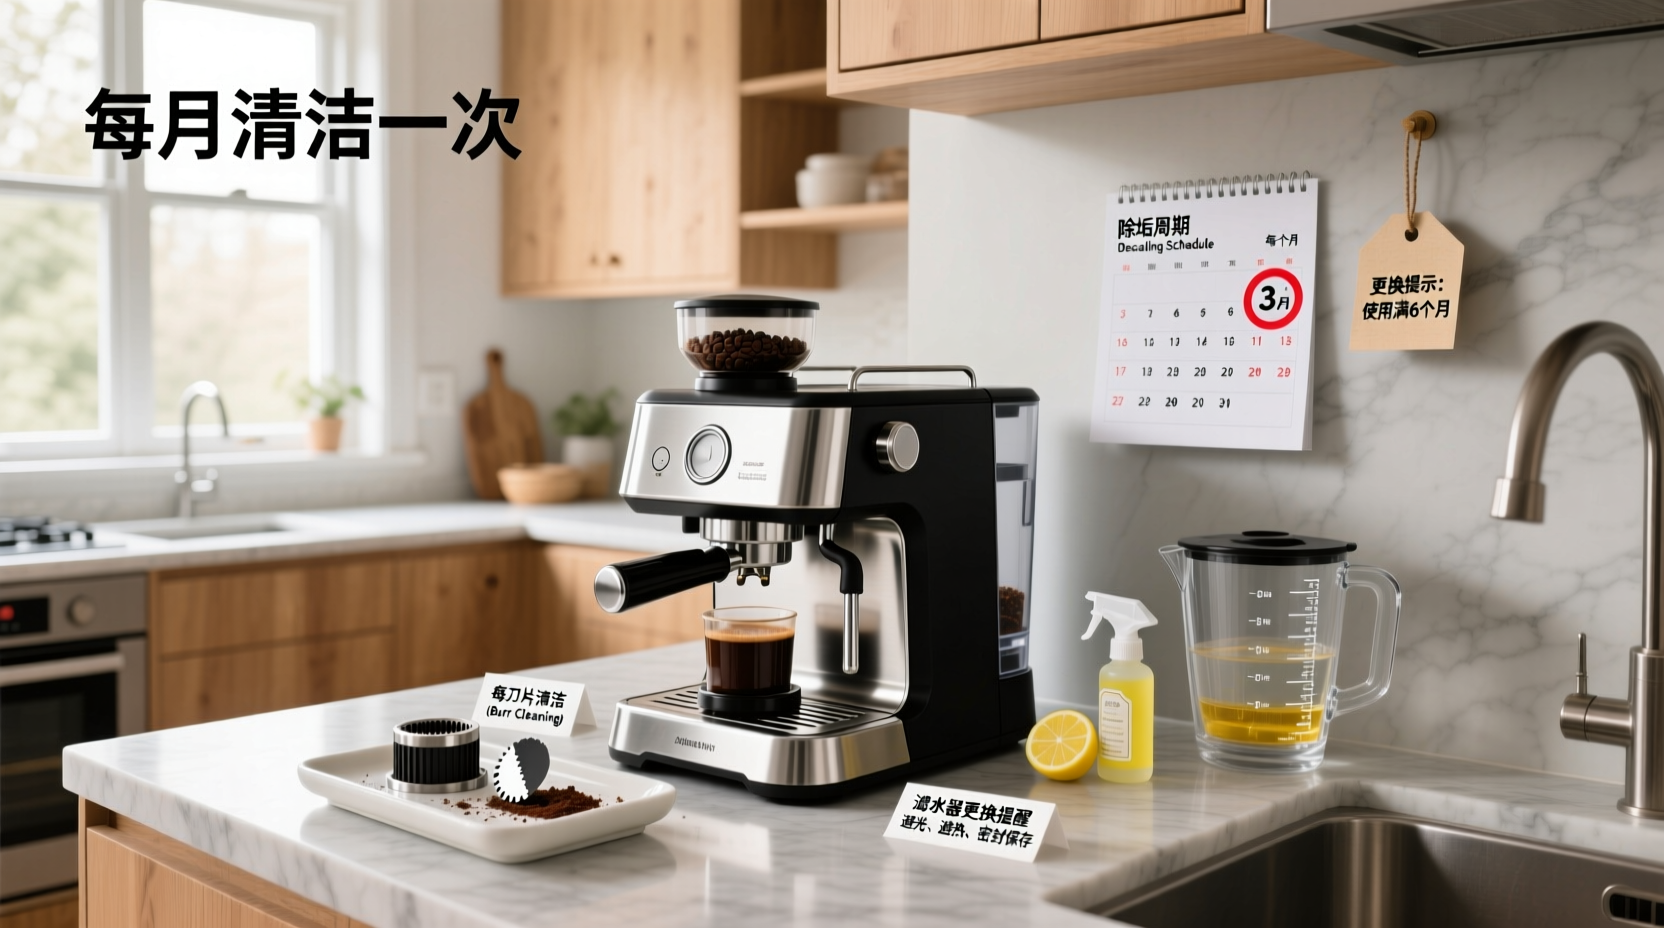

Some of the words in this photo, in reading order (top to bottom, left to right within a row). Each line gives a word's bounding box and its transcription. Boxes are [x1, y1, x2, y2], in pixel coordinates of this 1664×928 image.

[1117, 214, 1191, 239] 除垢周期
[1362, 299, 1450, 321] 使用满6个月
